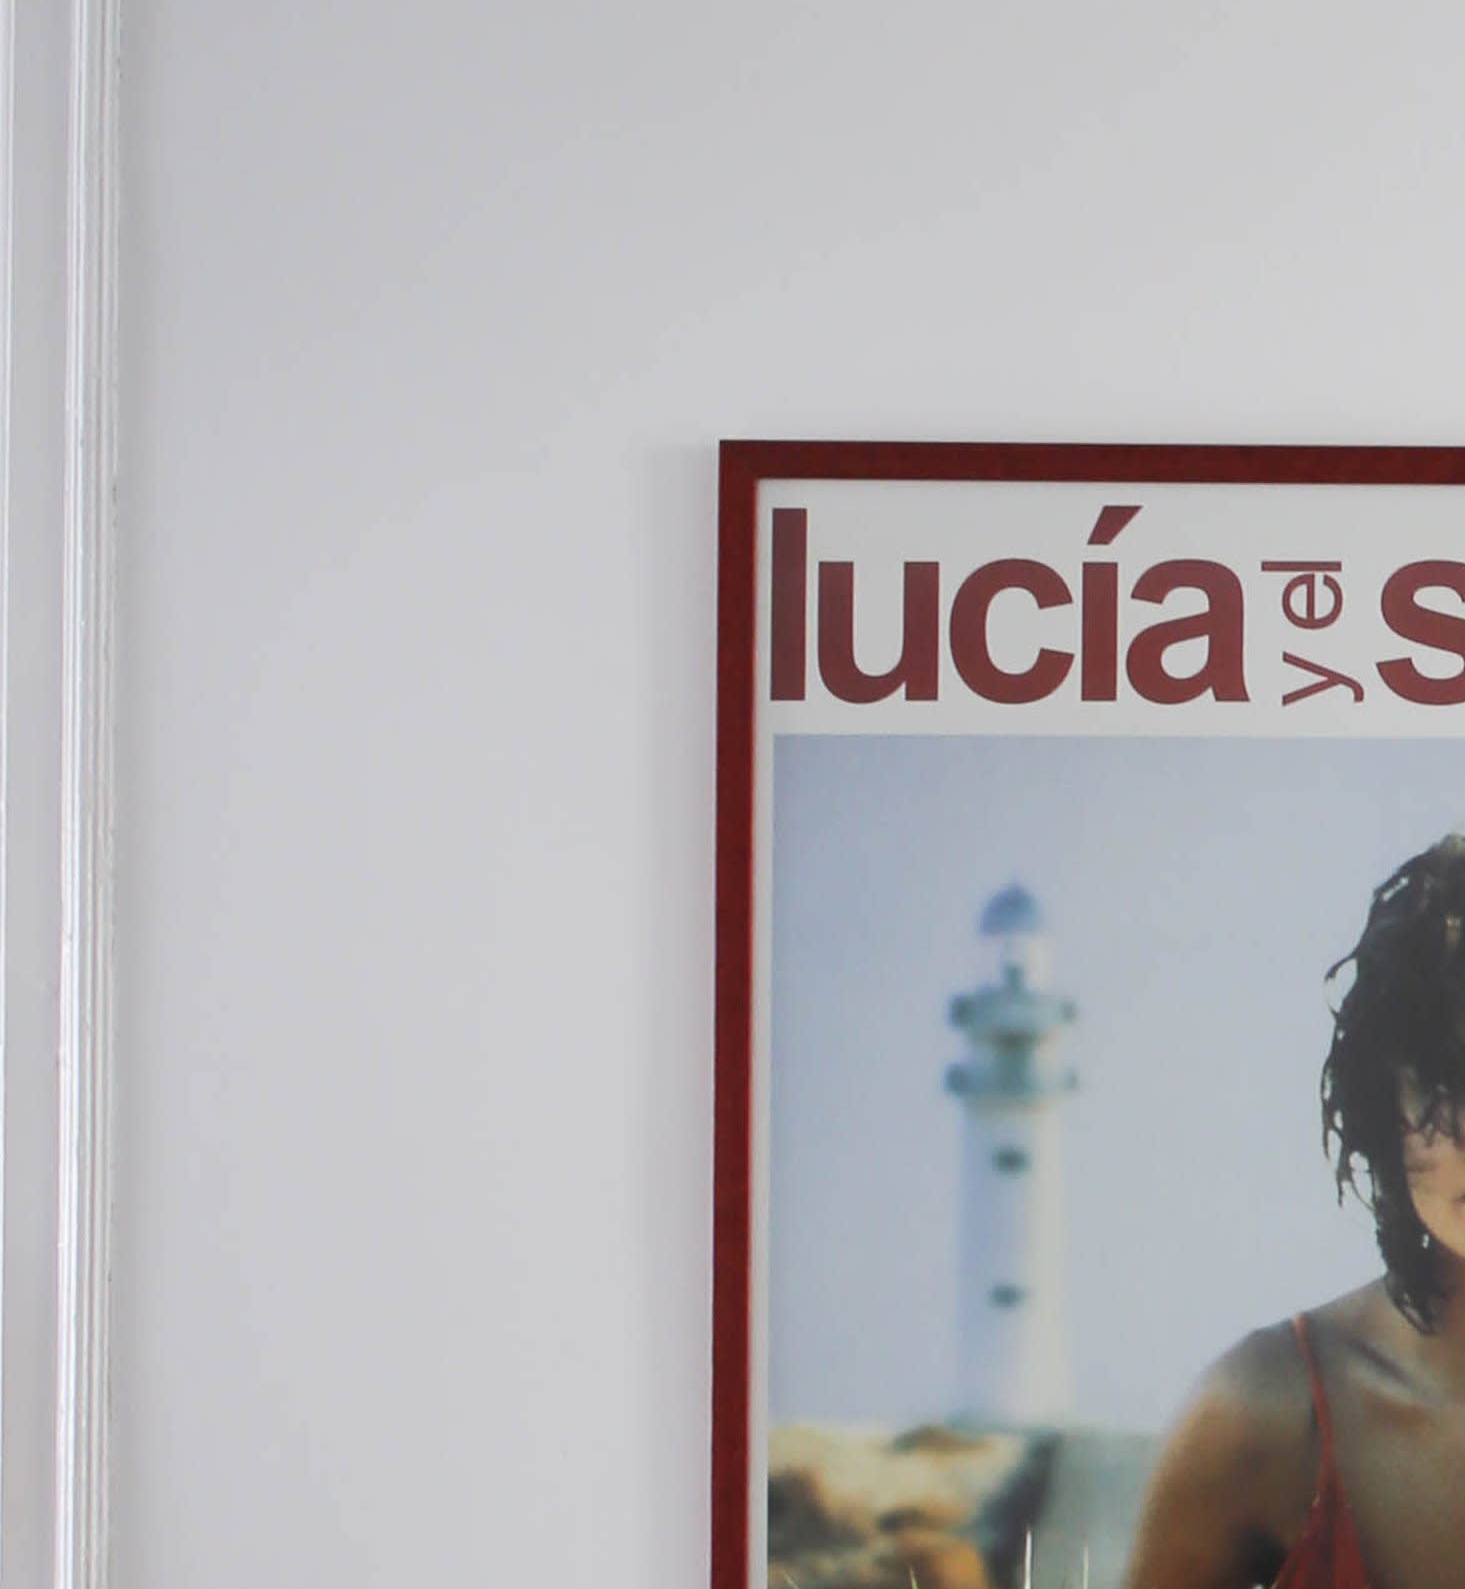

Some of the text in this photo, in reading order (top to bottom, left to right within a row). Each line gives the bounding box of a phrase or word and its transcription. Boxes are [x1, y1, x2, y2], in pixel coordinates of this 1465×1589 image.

[770, 506, 1249, 704] lucía
[1260, 560, 1344, 630] el
[1281, 650, 1365, 708] y
